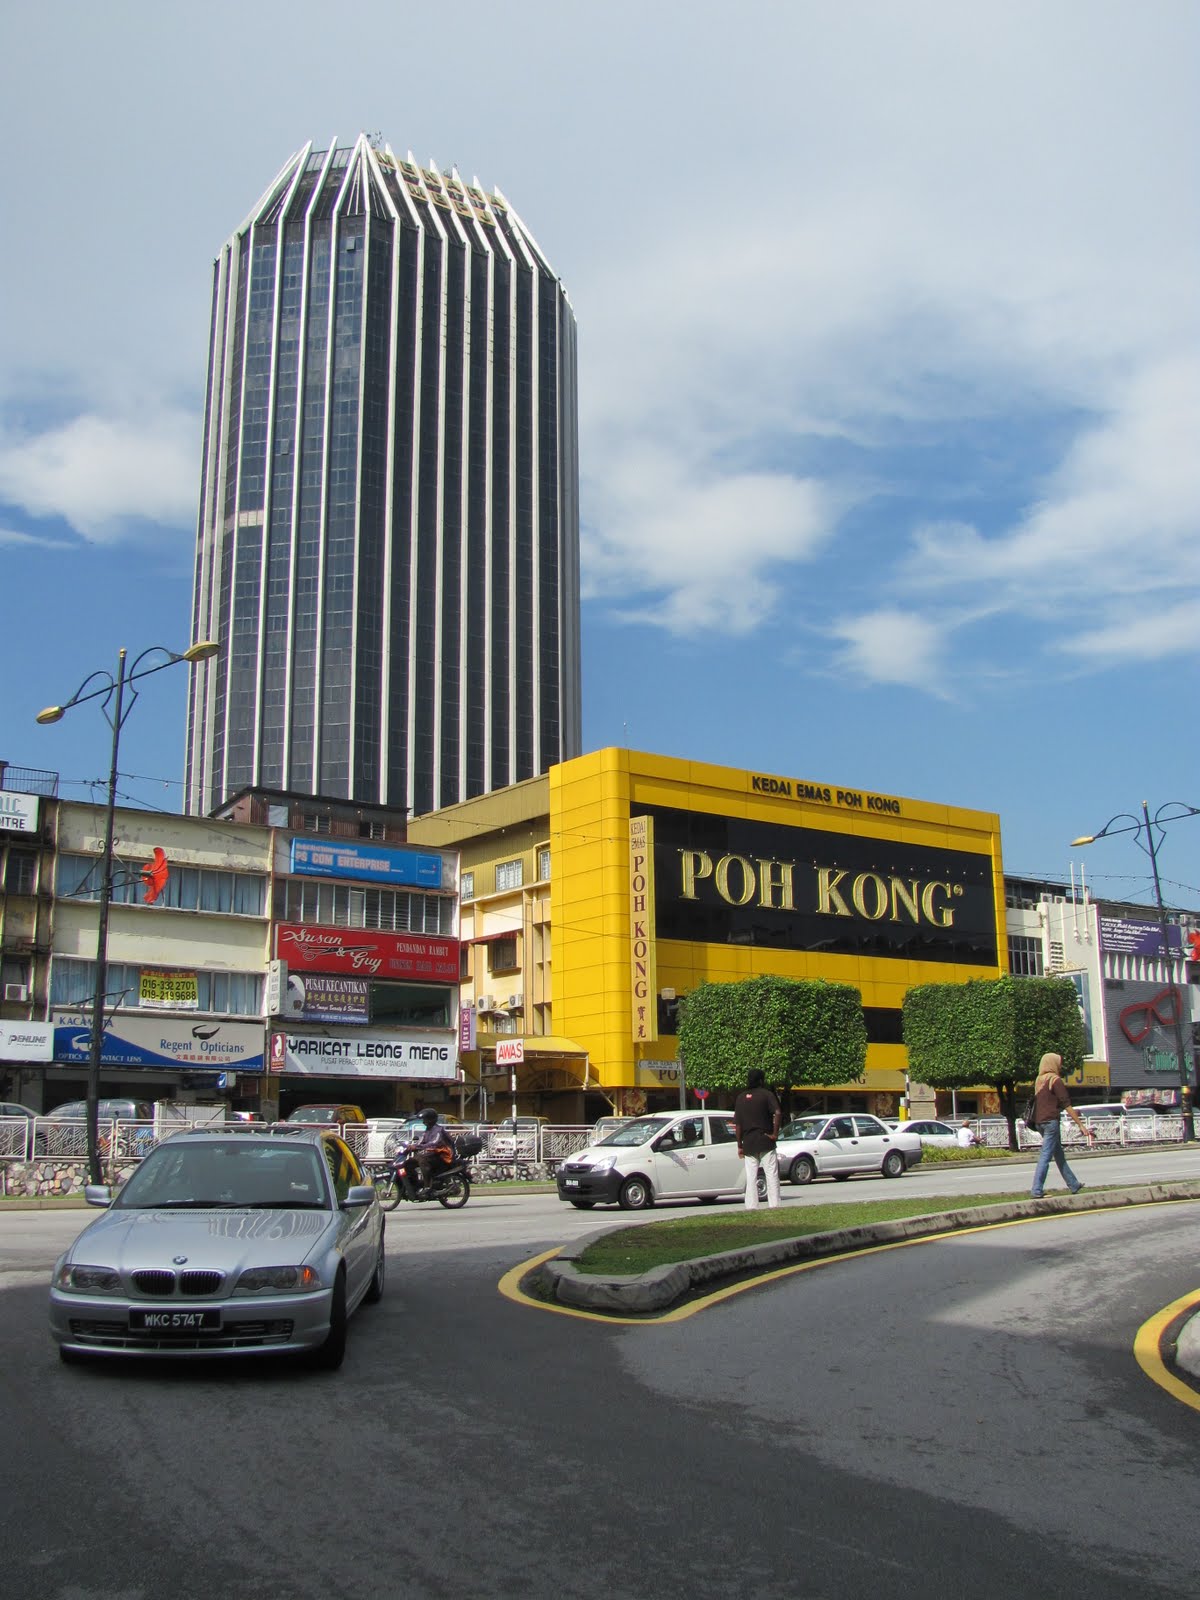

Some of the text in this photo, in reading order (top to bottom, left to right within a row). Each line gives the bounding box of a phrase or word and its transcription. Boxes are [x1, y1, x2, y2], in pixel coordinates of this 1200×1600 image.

[752, 776, 900, 813] KEDAI EMAS POH KONG
[631, 821, 645, 834] KEDAI
[631, 835, 645, 849] EMAS
[337, 855, 391, 872] ENTERPRISE
[677, 849, 955, 927] POH KONG
[633, 855, 648, 999] POH KONG
[282, 928, 342, 945] Susan
[428, 945, 449, 957] RAMBUT
[336, 947, 382, 974] & Guy
[305, 978, 368, 994] PUSAT KECANTIKAN
[160, 1039, 244, 1054] Regent Opticians
[286, 1039, 448, 1061] YARIKAT LEONG MENG
[498, 1042, 522, 1060] AWAS
[98, 1054, 124, 1062] ONTACT
[321, 1057, 337, 1065] PUSAT
[338, 1058, 362, 1066] PERABOT
[1086, 1075, 1106, 1084] TEXTILE
[145, 1313, 204, 1326] WKC 5747
